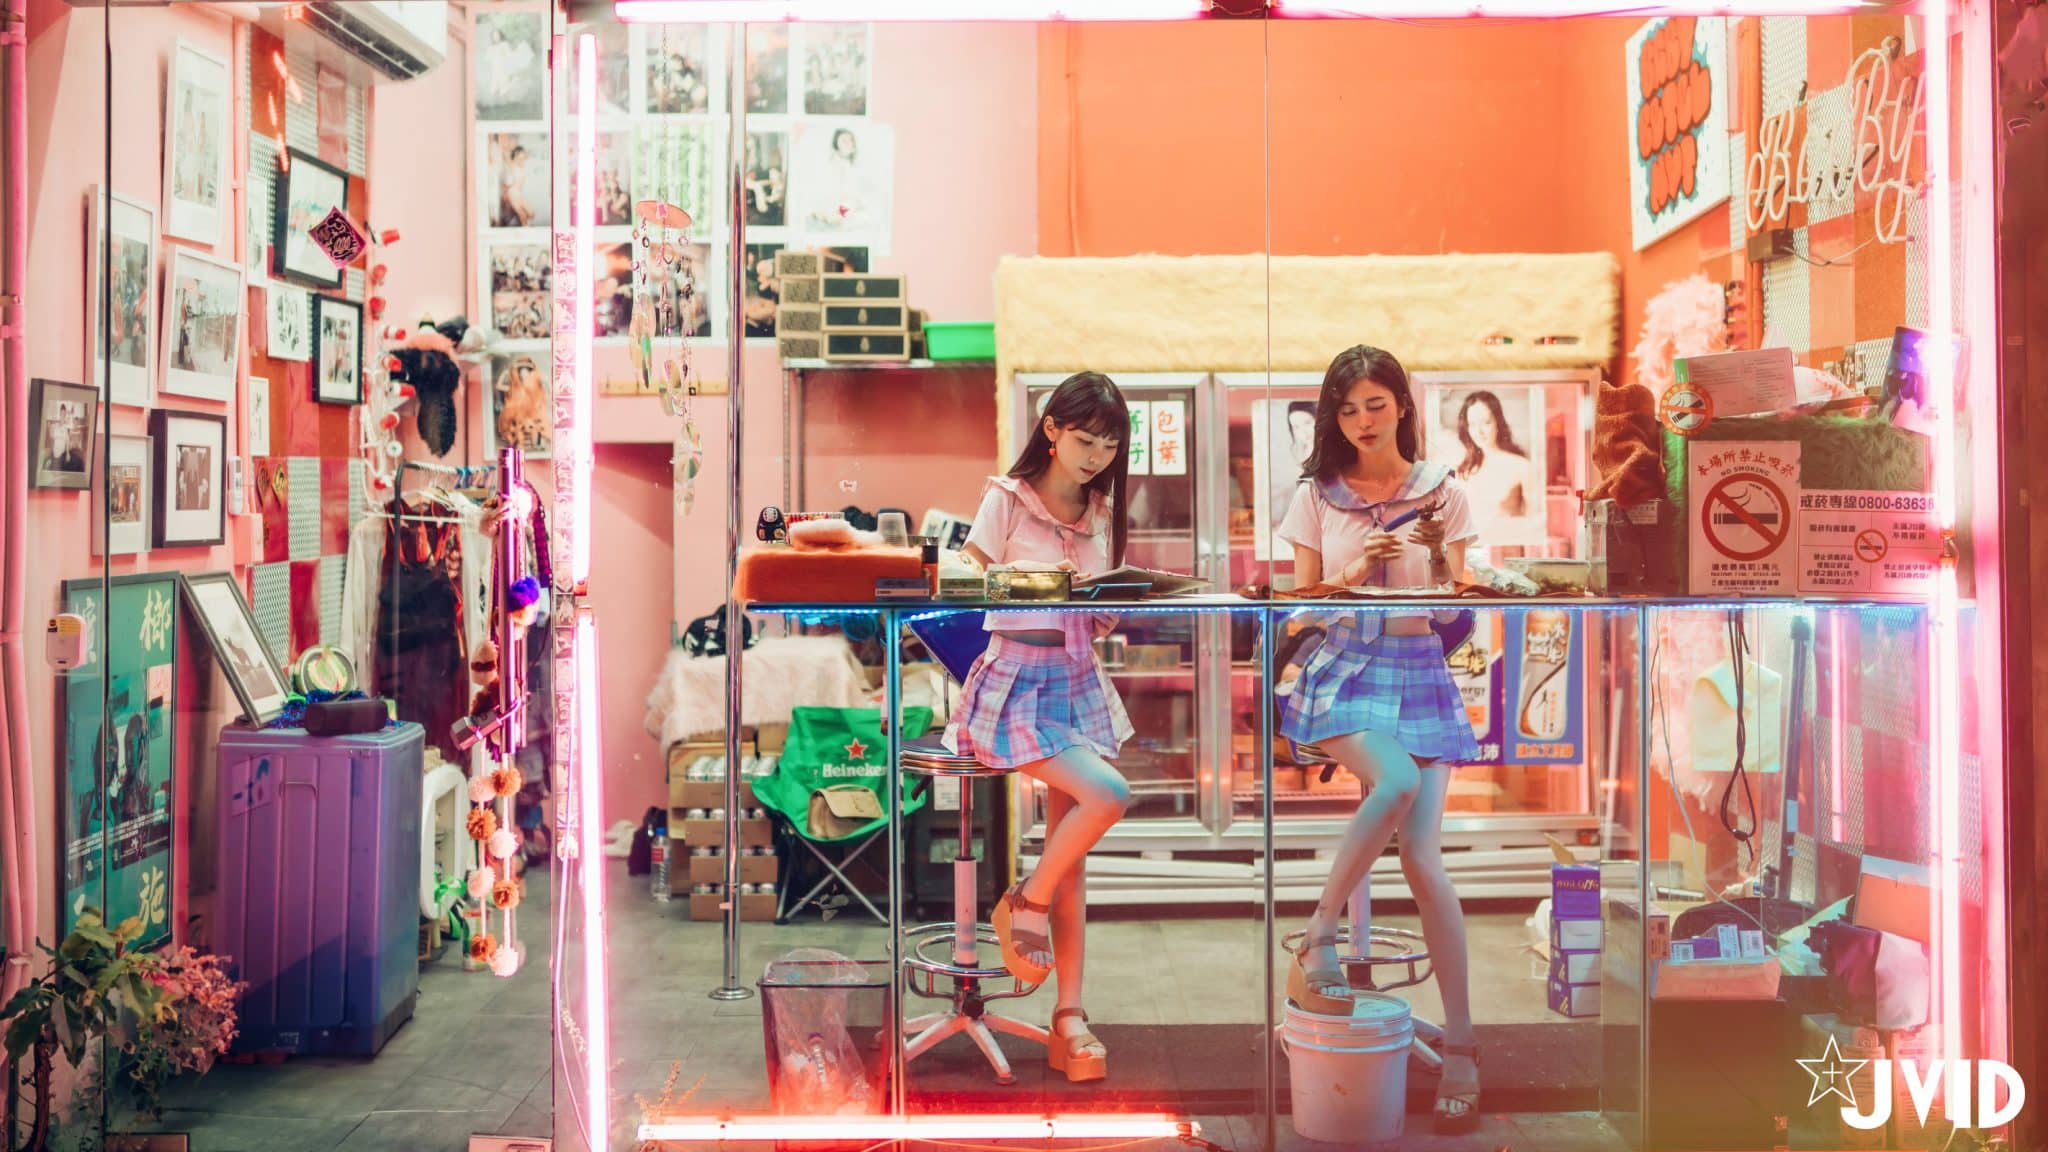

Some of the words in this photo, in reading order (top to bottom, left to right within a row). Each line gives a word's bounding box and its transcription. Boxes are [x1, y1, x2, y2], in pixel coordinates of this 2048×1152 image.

[1157, 410, 1179, 464] 包葉
[1721, 468, 1732, 476] NO
[1734, 465, 1771, 477] SMOKING
